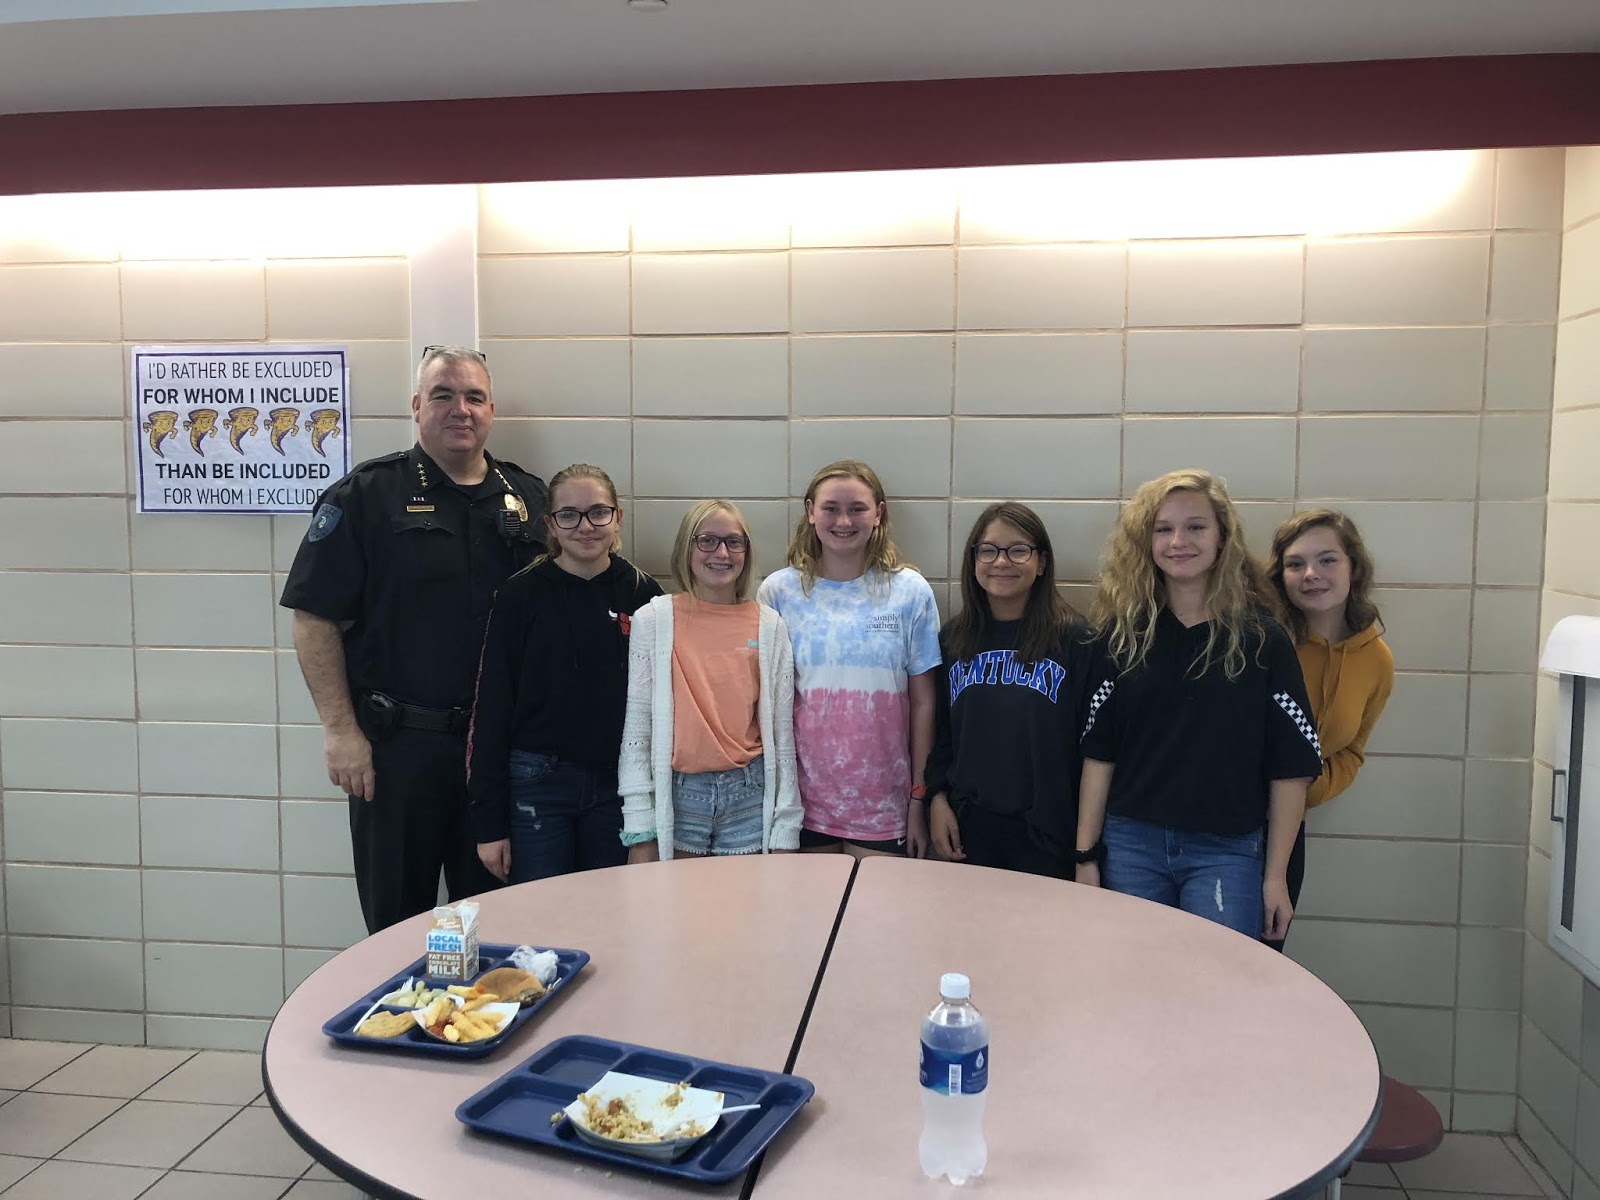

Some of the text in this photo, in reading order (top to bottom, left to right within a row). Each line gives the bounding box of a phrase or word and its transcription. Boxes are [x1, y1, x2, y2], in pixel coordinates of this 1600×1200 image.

[148, 361, 333, 379] I'D RATHER BE EXCLUDED
[143, 387, 340, 404] FOR WHOM I INCLUDE
[155, 463, 330, 479] THAN BE INCLUDED
[164, 488, 192, 504] FOR
[196, 488, 243, 505] WHOM
[873, 613, 900, 623] simply
[865, 621, 899, 629] southern
[429, 935, 461, 943] LOCAL
[429, 943, 461, 952] FRESH
[428, 965, 460, 976] MILK
